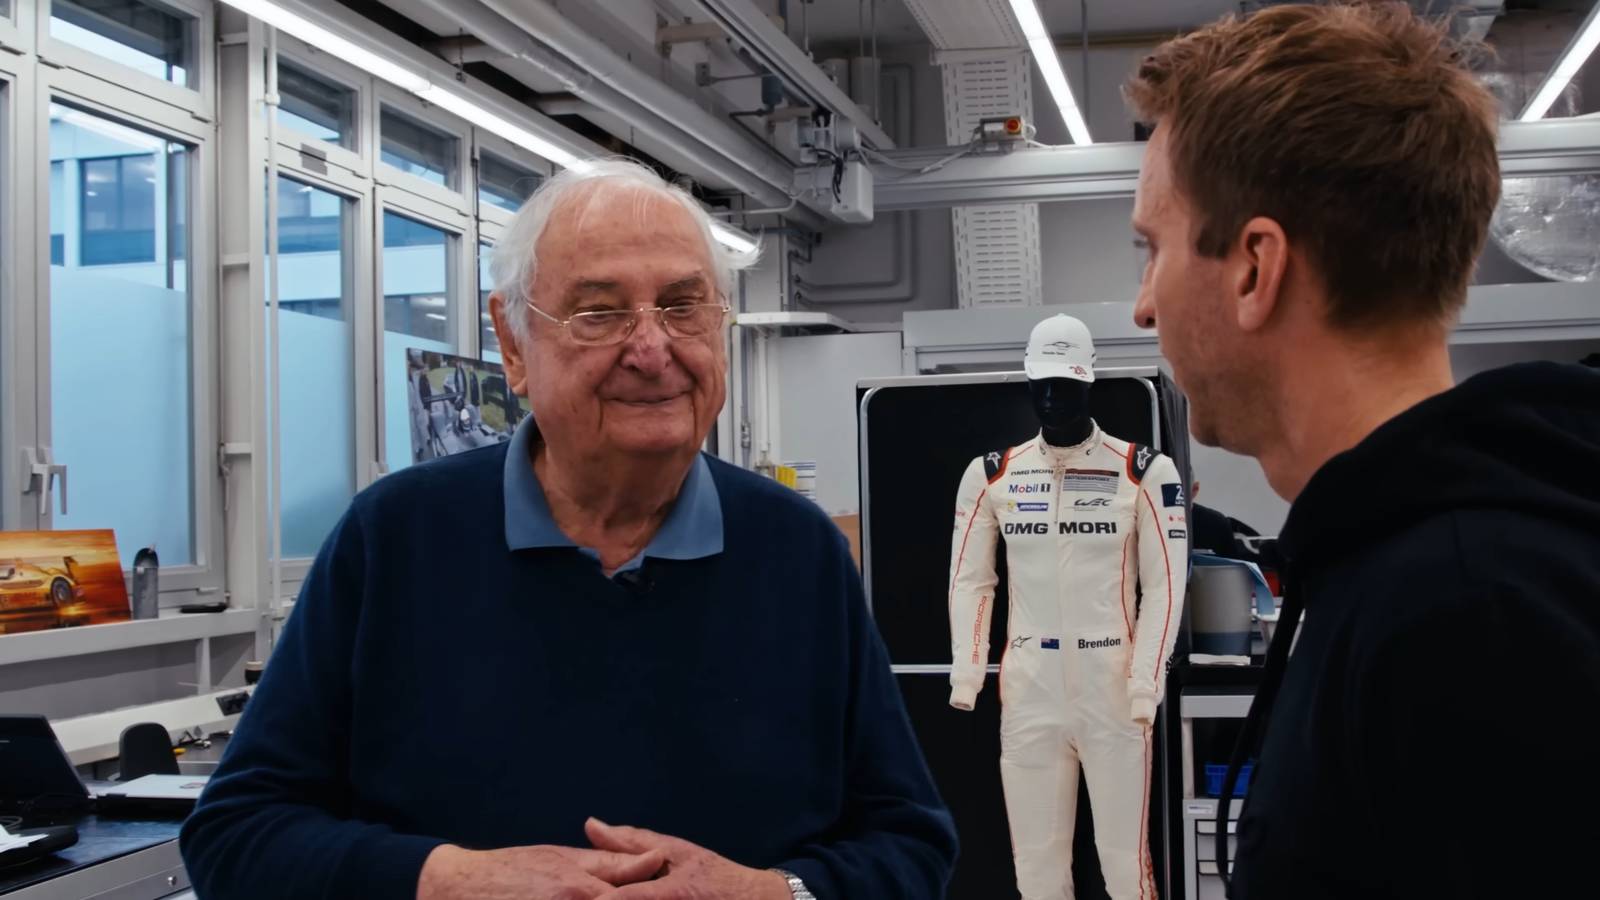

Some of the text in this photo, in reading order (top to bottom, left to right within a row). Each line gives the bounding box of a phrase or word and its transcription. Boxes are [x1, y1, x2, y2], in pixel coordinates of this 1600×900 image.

[1008, 482, 1038, 493] Mobil
[1004, 521, 1117, 535] DMG MORI
[972, 595, 987, 665] PORSCHE
[1078, 636, 1121, 649] Brendon
